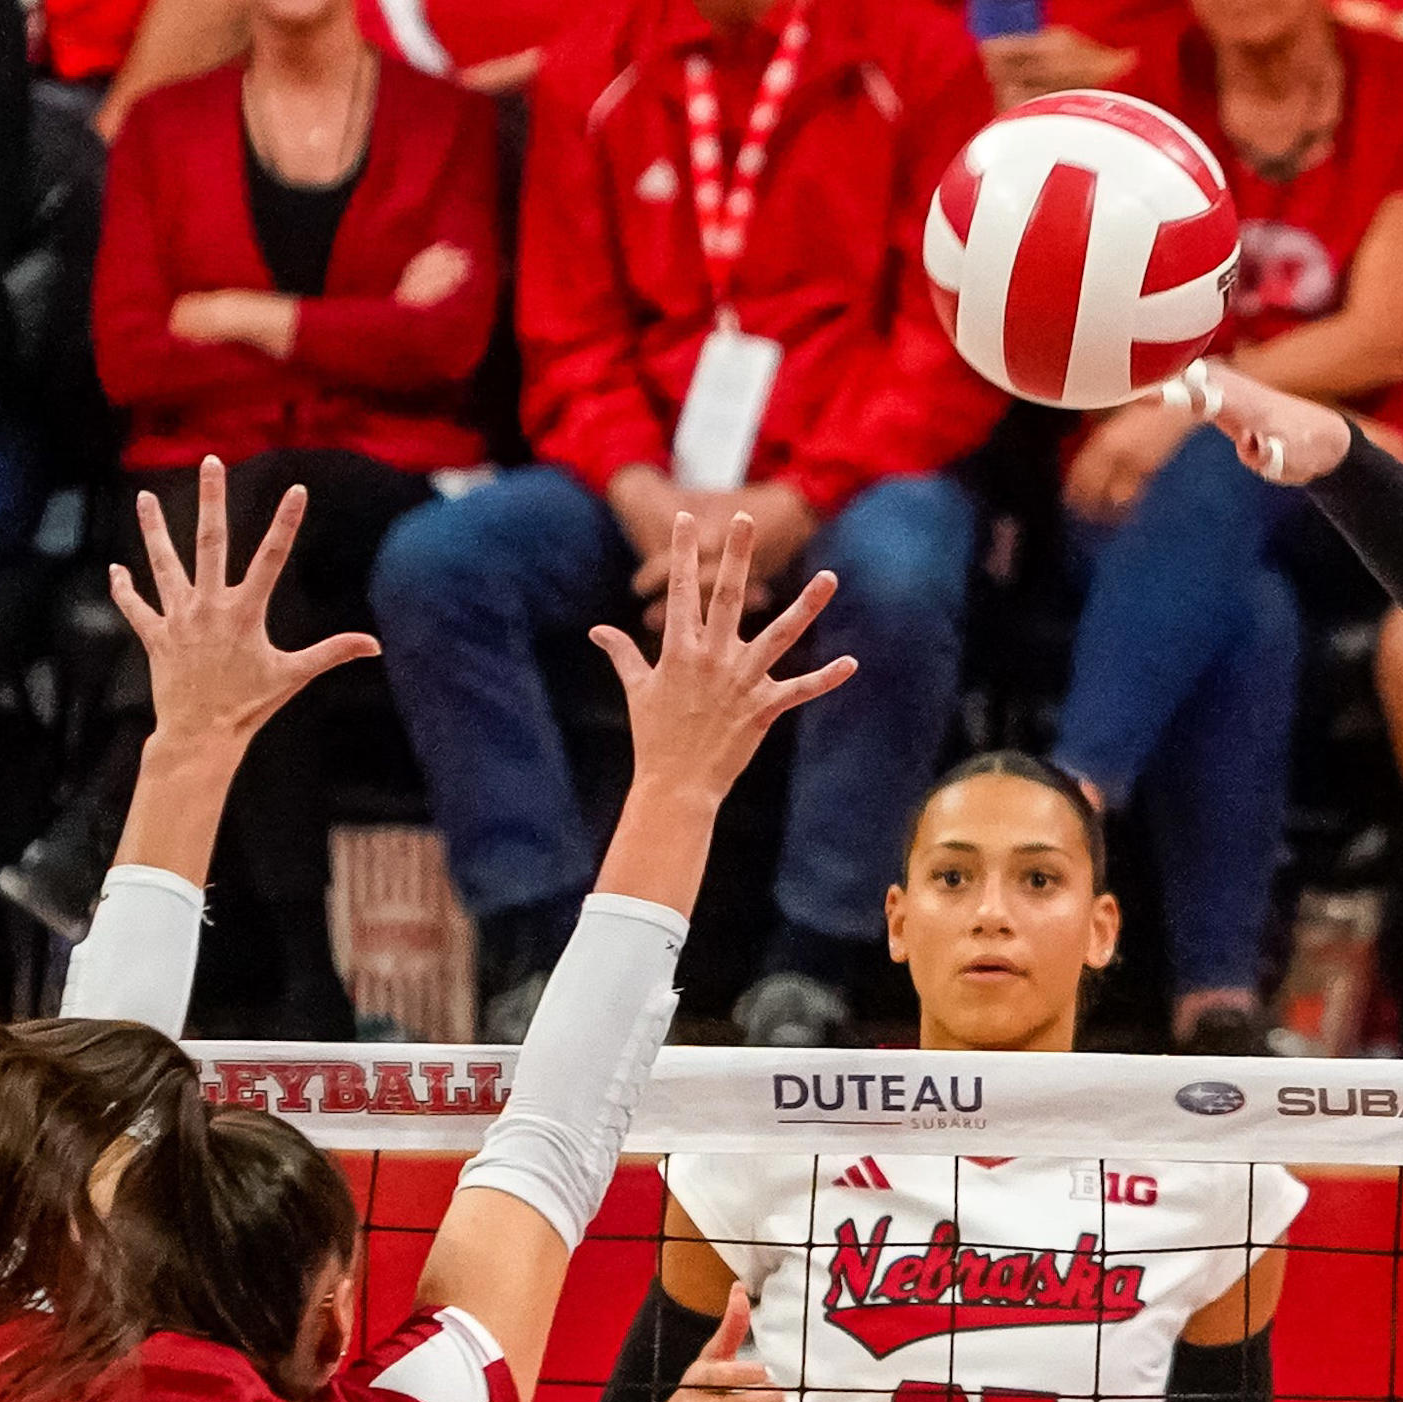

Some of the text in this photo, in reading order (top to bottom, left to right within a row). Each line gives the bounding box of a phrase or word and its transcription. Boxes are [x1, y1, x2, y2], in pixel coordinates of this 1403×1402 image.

[773, 1073, 983, 1113] DUTEAU
[910, 1117, 987, 1131] SUBARU
[824, 1214, 1146, 1309] Nebraska
